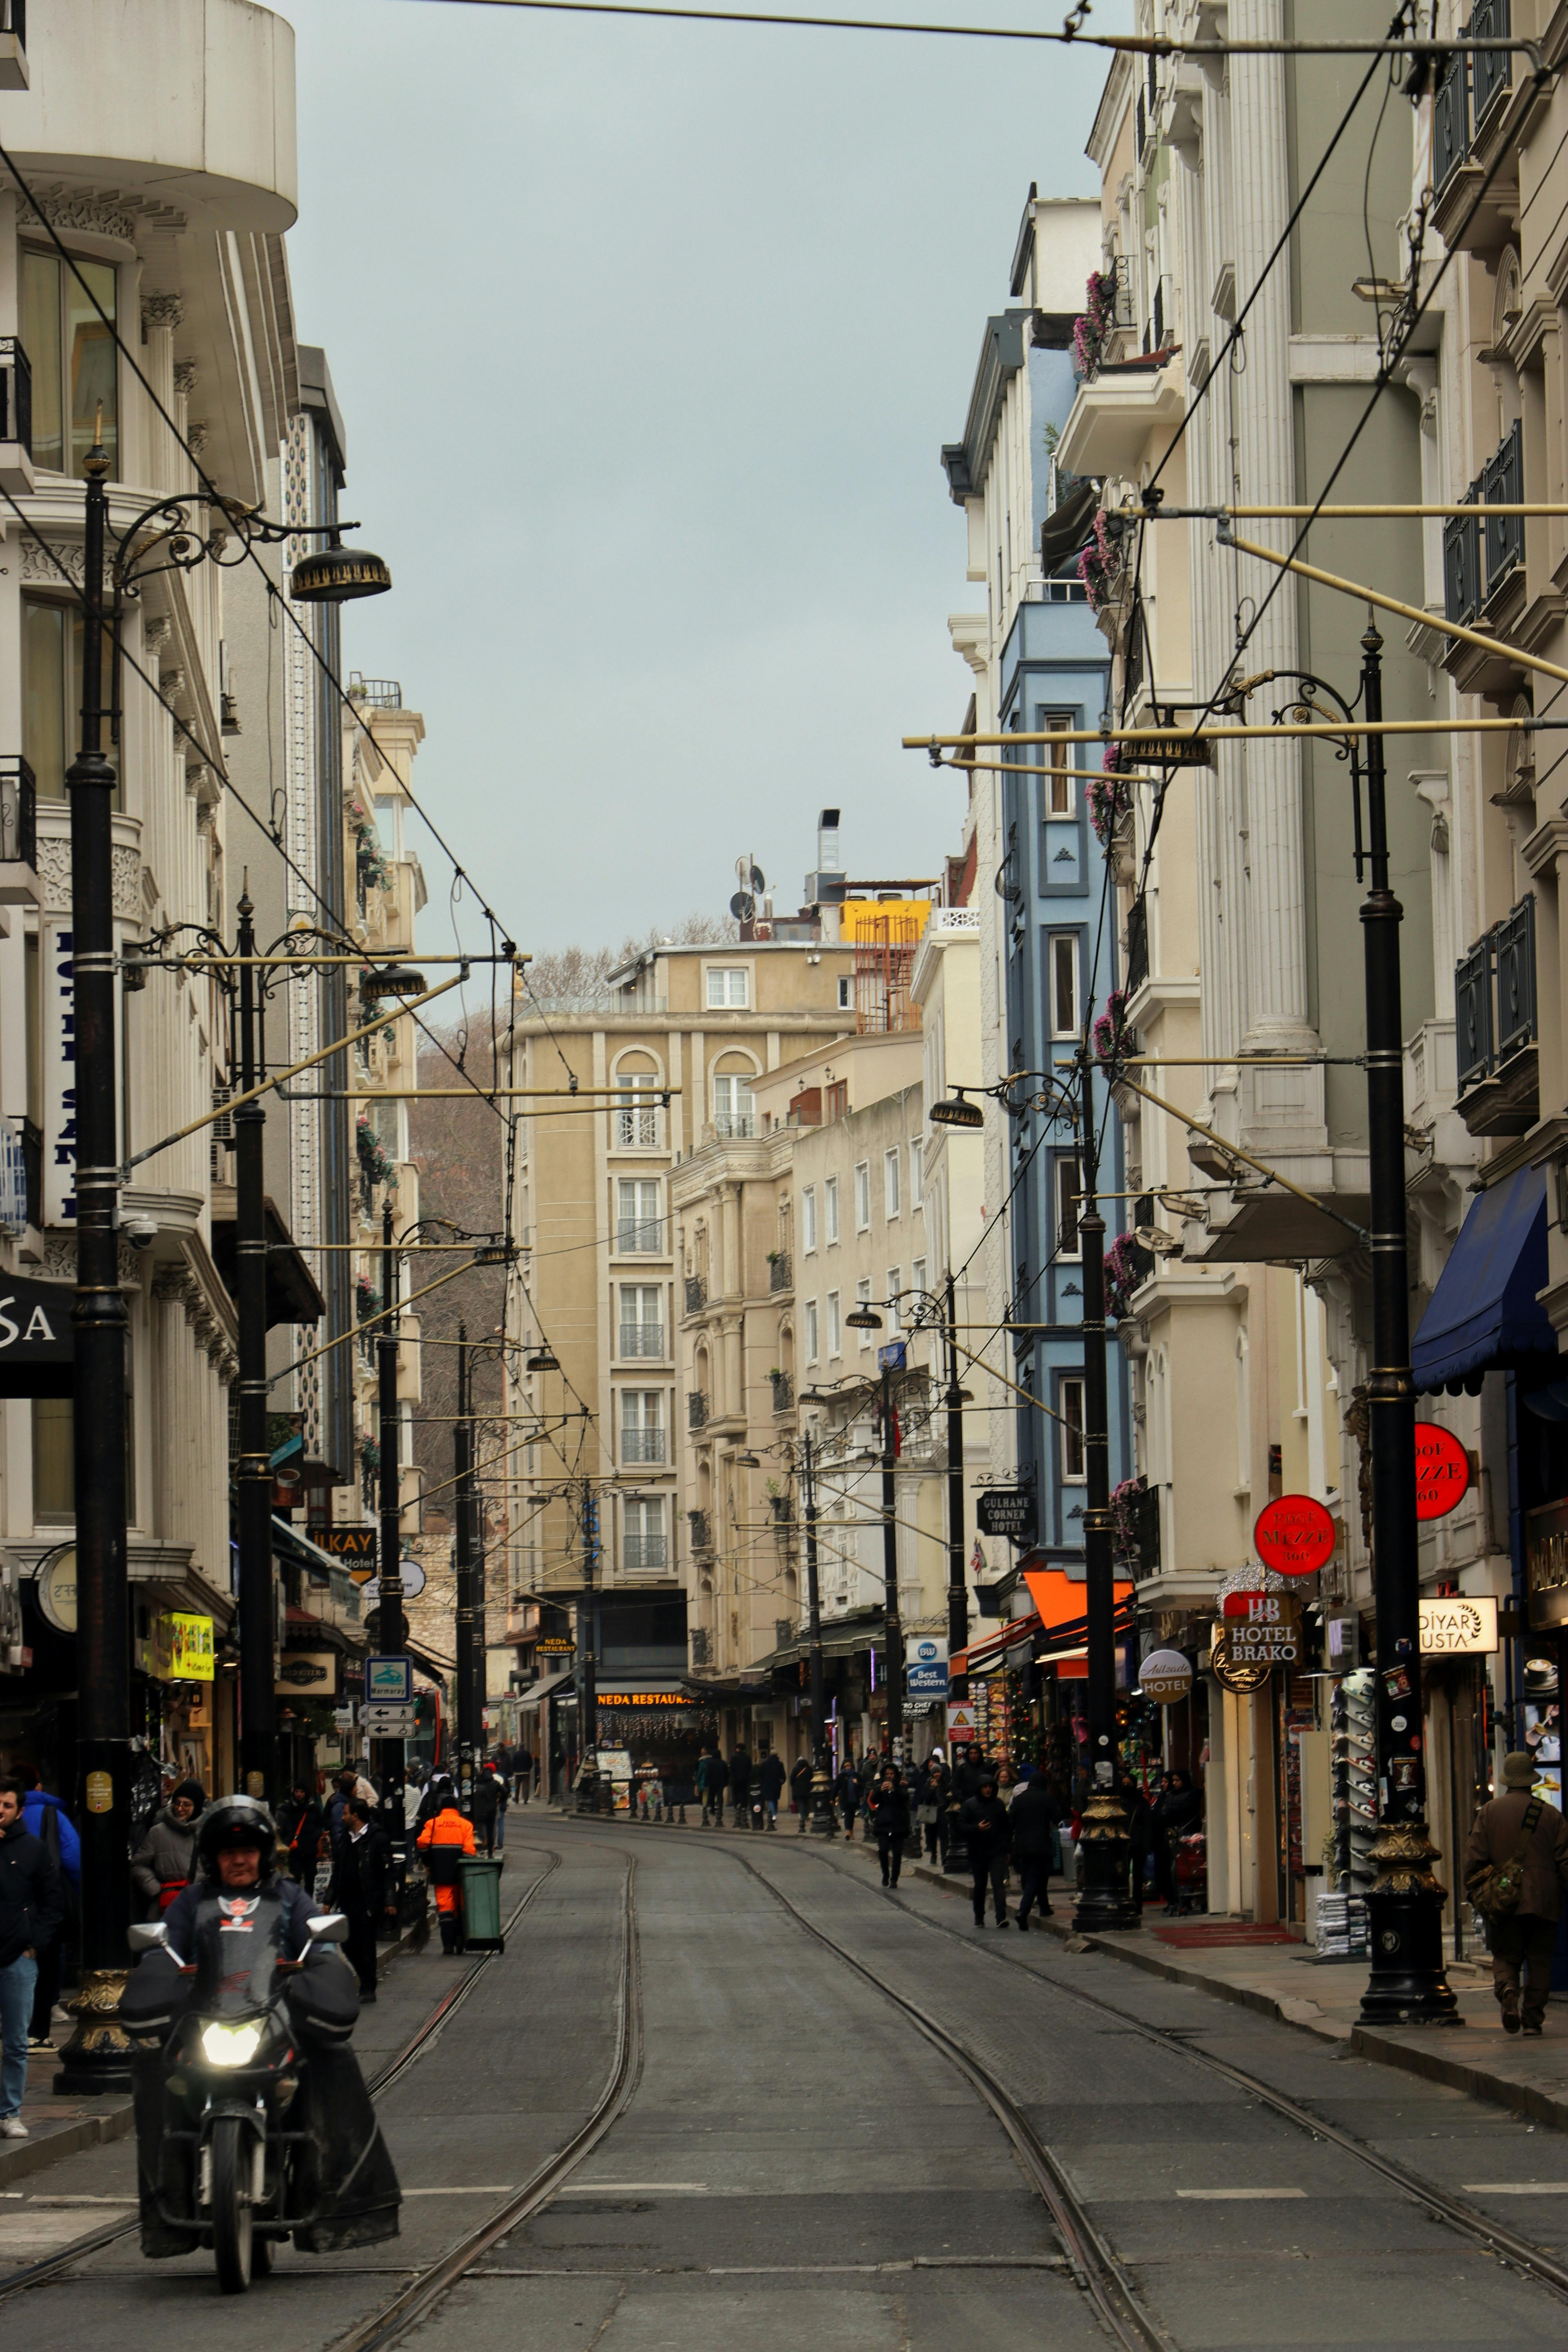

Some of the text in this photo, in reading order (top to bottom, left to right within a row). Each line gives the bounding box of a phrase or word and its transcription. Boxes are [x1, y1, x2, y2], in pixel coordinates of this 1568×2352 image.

[1416, 1462, 1461, 1481] ZZE
[984, 1495, 1029, 1508] GÜLHANE
[1417, 1488, 1438, 1502] 60
[988, 1510, 1025, 1520] CORNER
[992, 1521, 1022, 1532] HOTEL
[1263, 1529, 1329, 1544] MEZZE
[1283, 1550, 1310, 1562] 360
[343, 1559, 374, 1568] Hotel
[1419, 1611, 1470, 1630] DİYAR
[1232, 1627, 1296, 1642] HOTEL
[1422, 1633, 1468, 1648] USTA
[920, 1648, 935, 1656] BW
[1232, 1646, 1296, 1661] BRAKO
[918, 1671, 937, 1679] Best
[1145, 1680, 1188, 1693] HOTEL
[598, 1694, 704, 1705] NEDA RESTAUR
